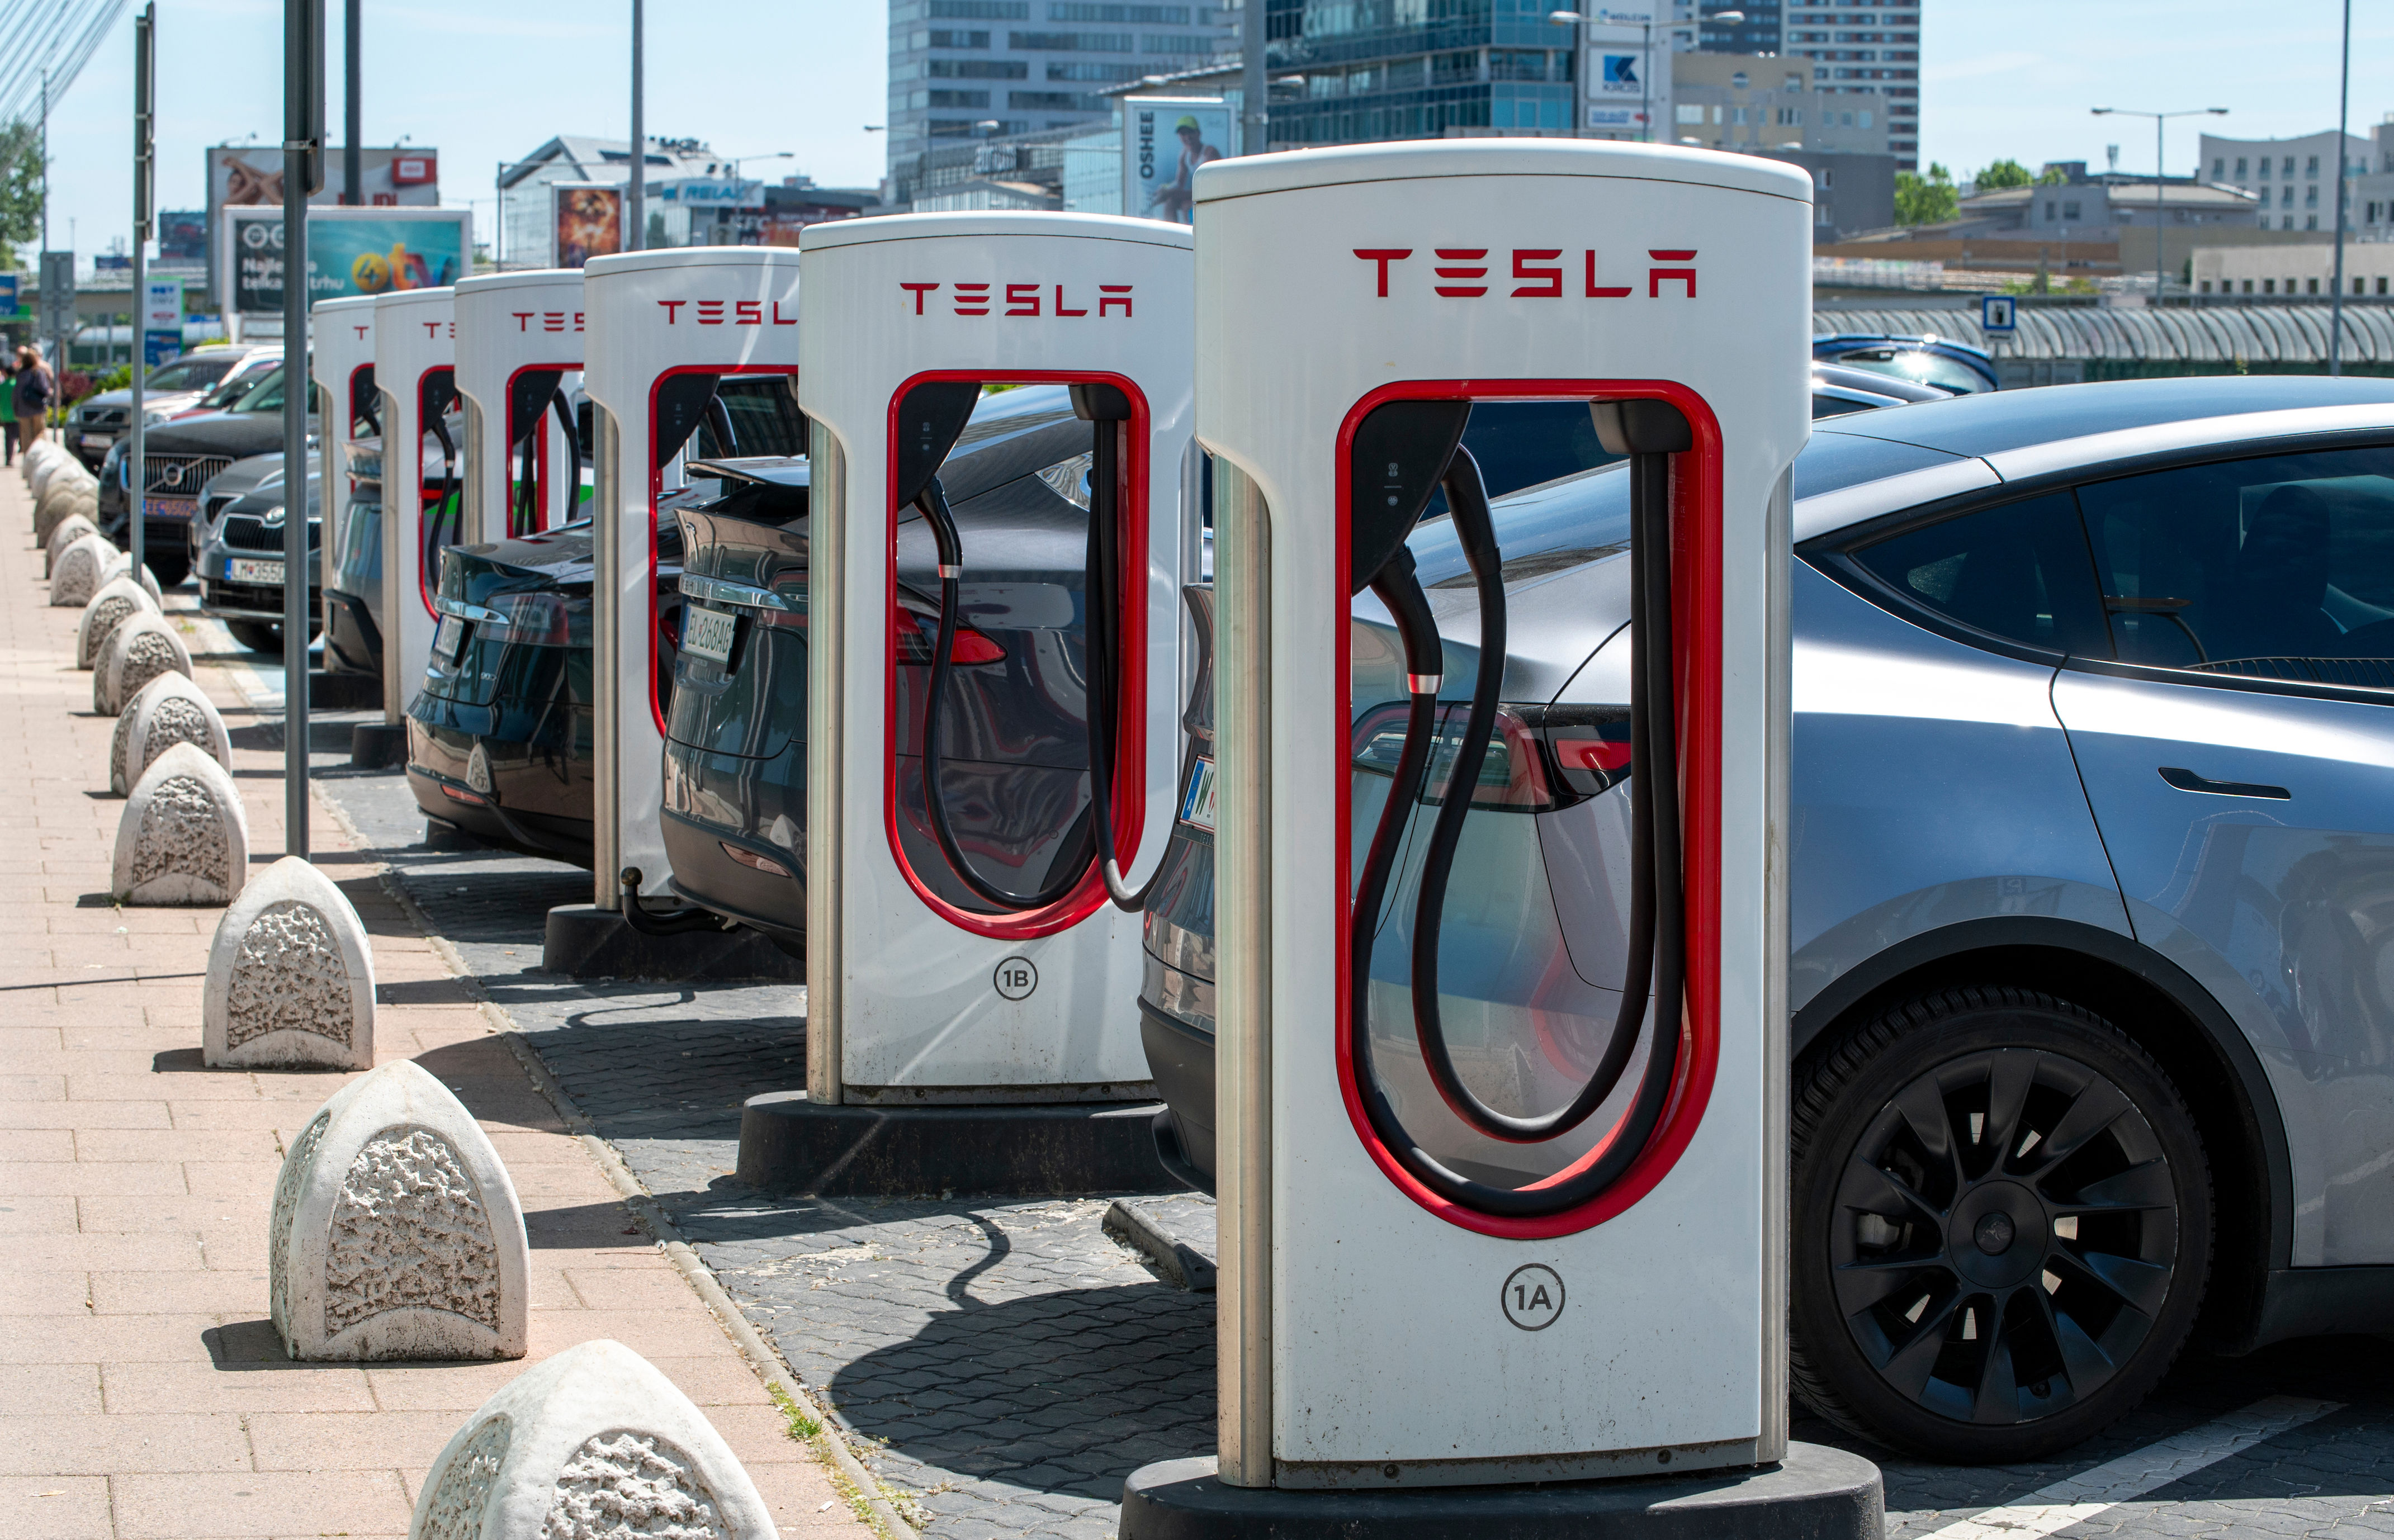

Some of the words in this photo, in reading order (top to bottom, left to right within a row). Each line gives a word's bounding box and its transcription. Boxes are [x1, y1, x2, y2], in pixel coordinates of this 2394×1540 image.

[1140, 112, 1153, 179] OSHEE
[1353, 249, 1697, 298] TESLA
[658, 301, 797, 325] TESL
[900, 283, 1133, 317] TESLA
[512, 312, 584, 331] TES
[233, 561, 247, 579] LM
[254, 562, 285, 581] 355
[688, 613, 698, 645] EL
[699, 617, 731, 653] 268AG
[1187, 798, 1193, 812] A
[1195, 769, 1214, 816] W
[1003, 970, 1029, 987] 1B
[1514, 1284, 1553, 1311] 1A
